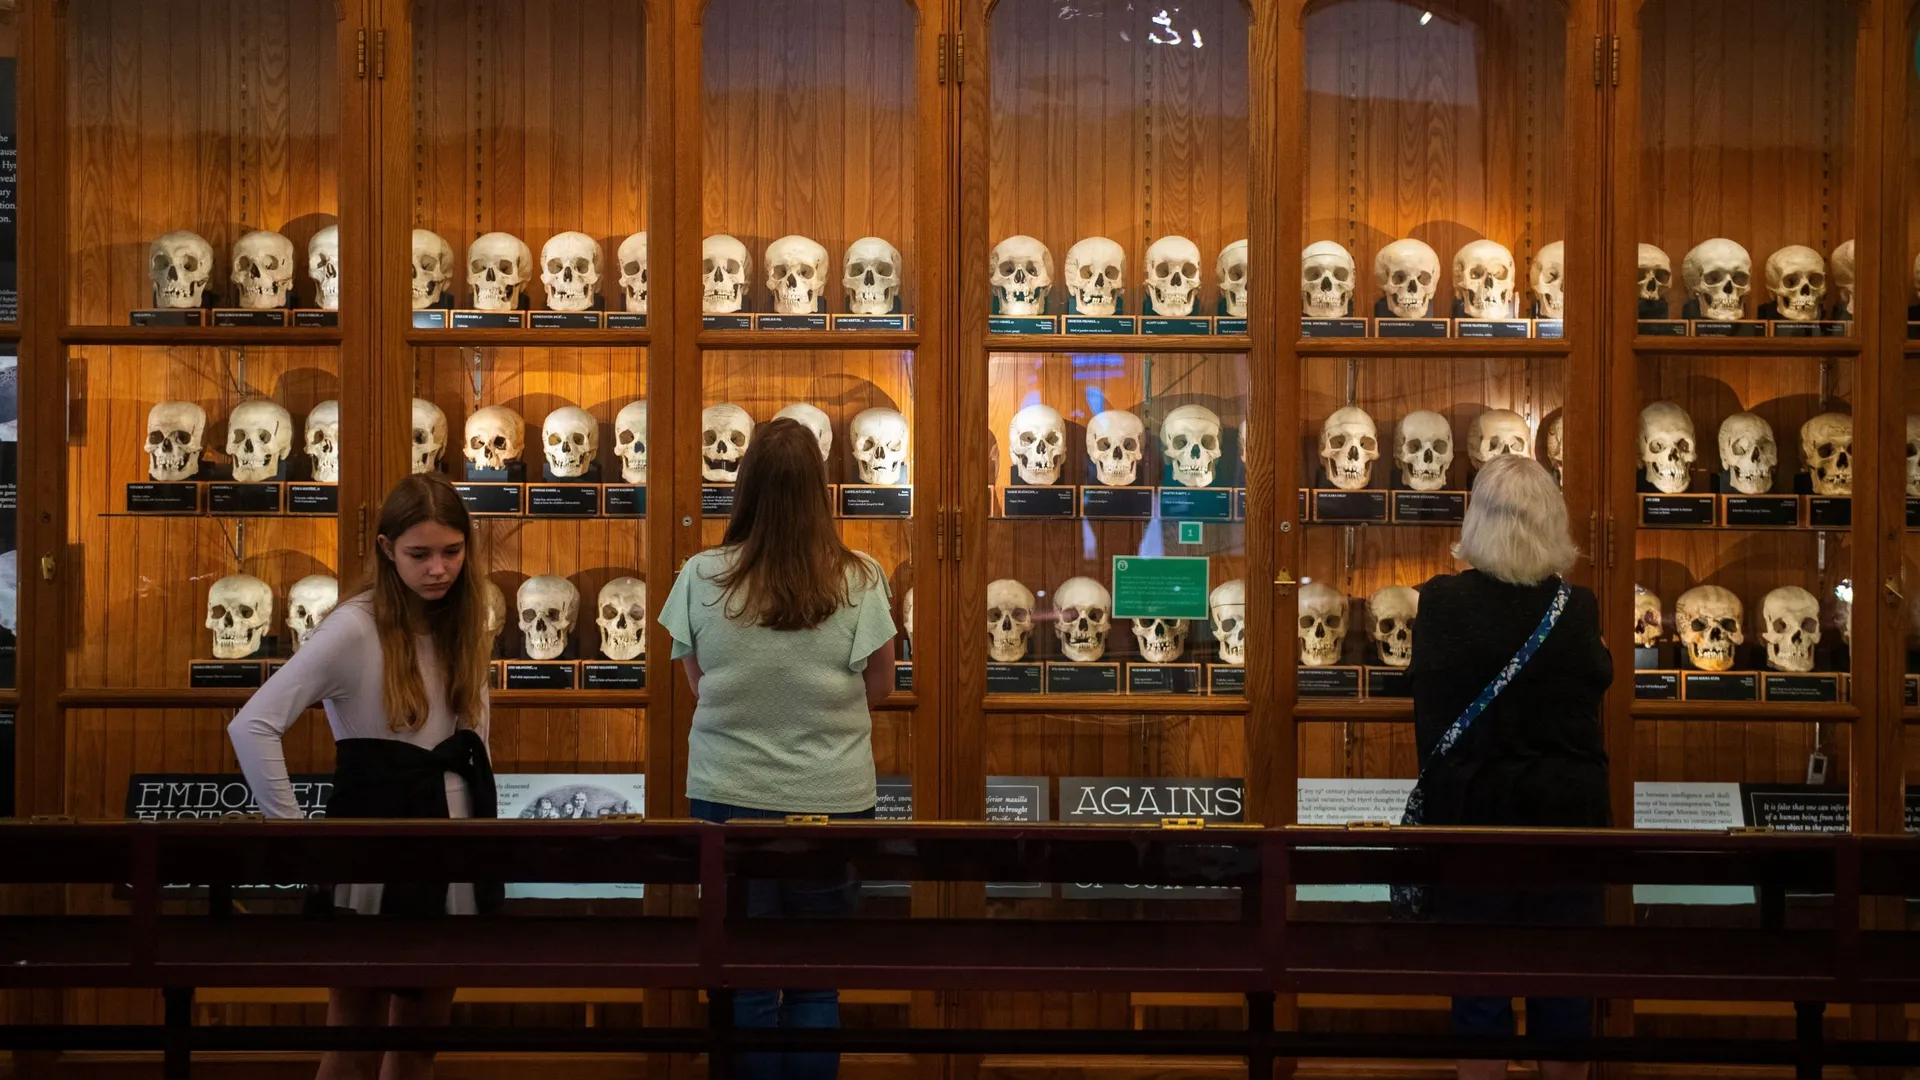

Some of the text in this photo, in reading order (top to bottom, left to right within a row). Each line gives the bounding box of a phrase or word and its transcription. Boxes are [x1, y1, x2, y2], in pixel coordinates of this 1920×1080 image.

[136, 783, 334, 808] EMBOED
[1071, 786, 1244, 816] AGAINS
[1006, 805, 1028, 814] brought
[1792, 803, 1805, 811] that
[1801, 813, 1818, 822] being
[1787, 822, 1804, 832] object
[1812, 823, 1822, 831] the
[1823, 824, 1845, 833] general
